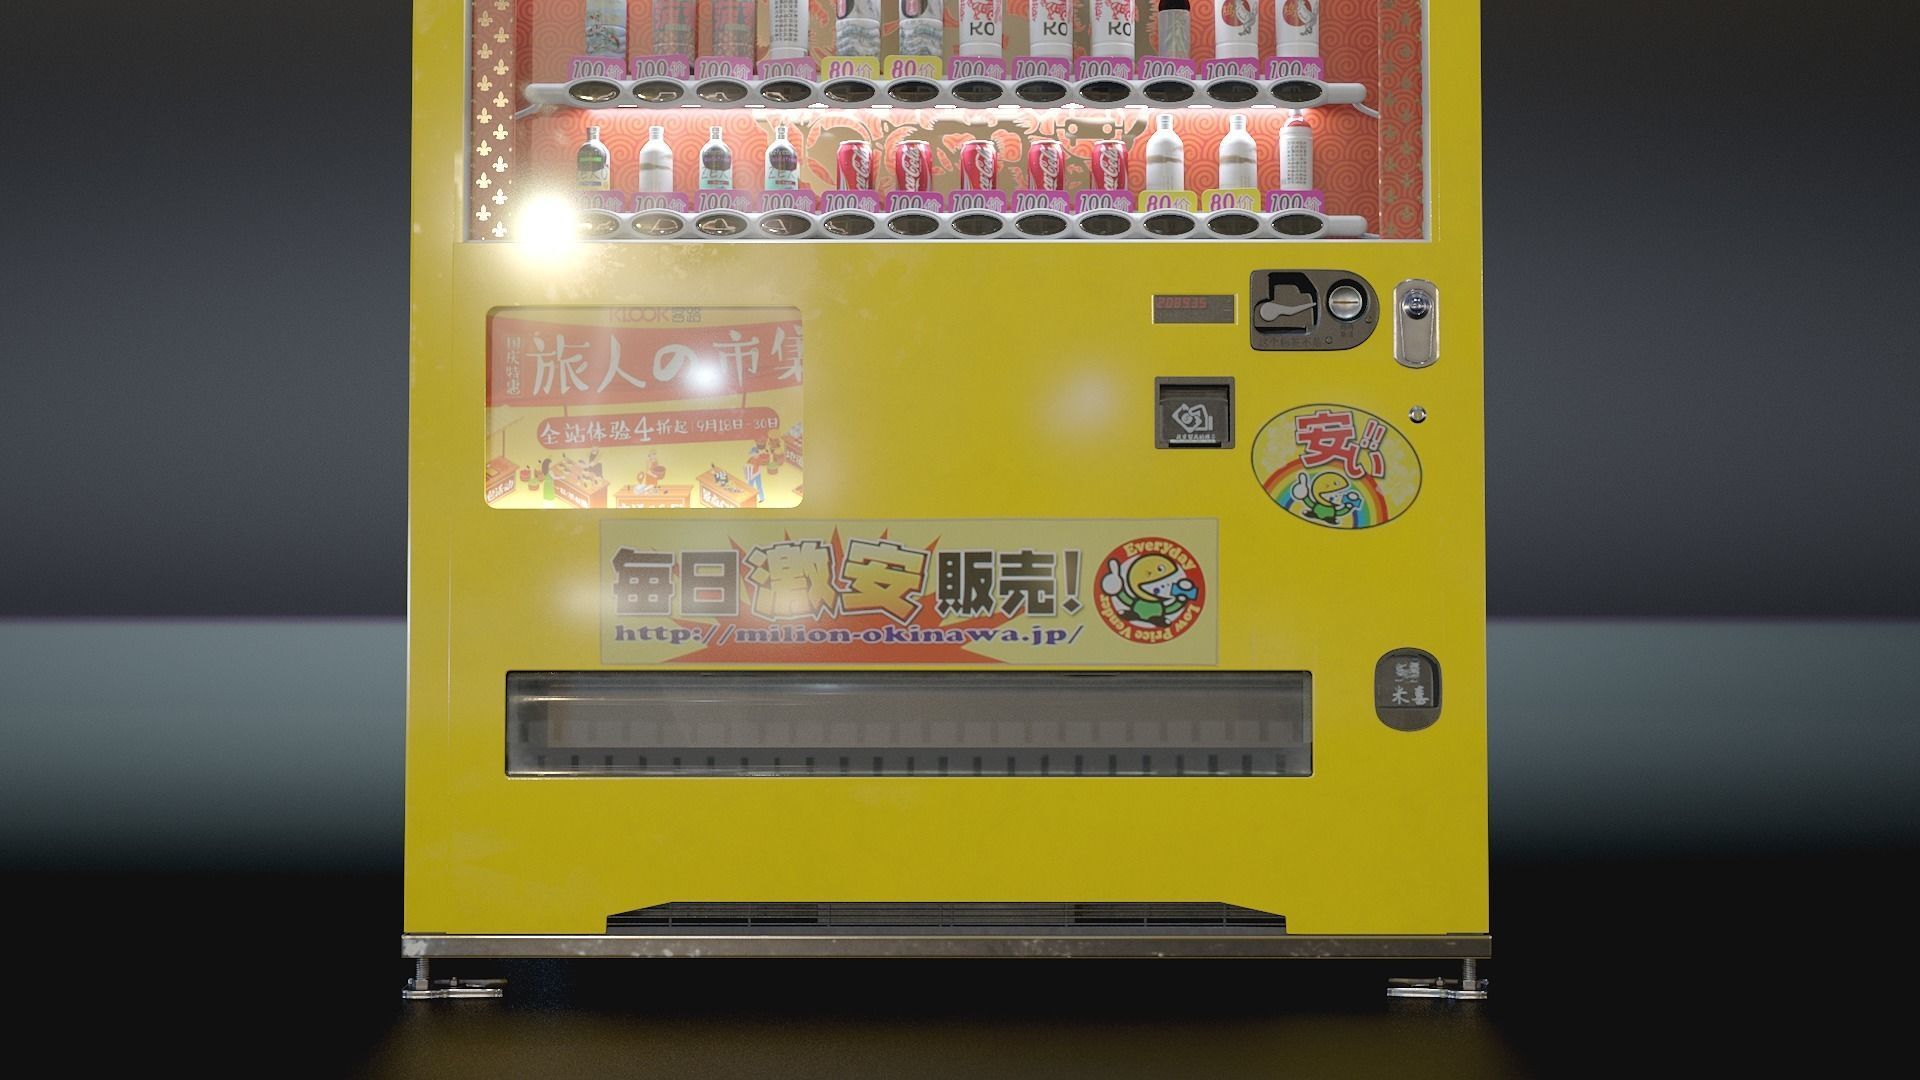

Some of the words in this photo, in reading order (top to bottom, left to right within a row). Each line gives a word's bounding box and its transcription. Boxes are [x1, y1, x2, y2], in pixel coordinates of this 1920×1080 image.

[1123, 541, 1197, 570] Everyday
[1174, 604, 1200, 632] Low
[614, 624, 1084, 645] http://milion-okinawa.jp/
[1134, 628, 1174, 643] Price
